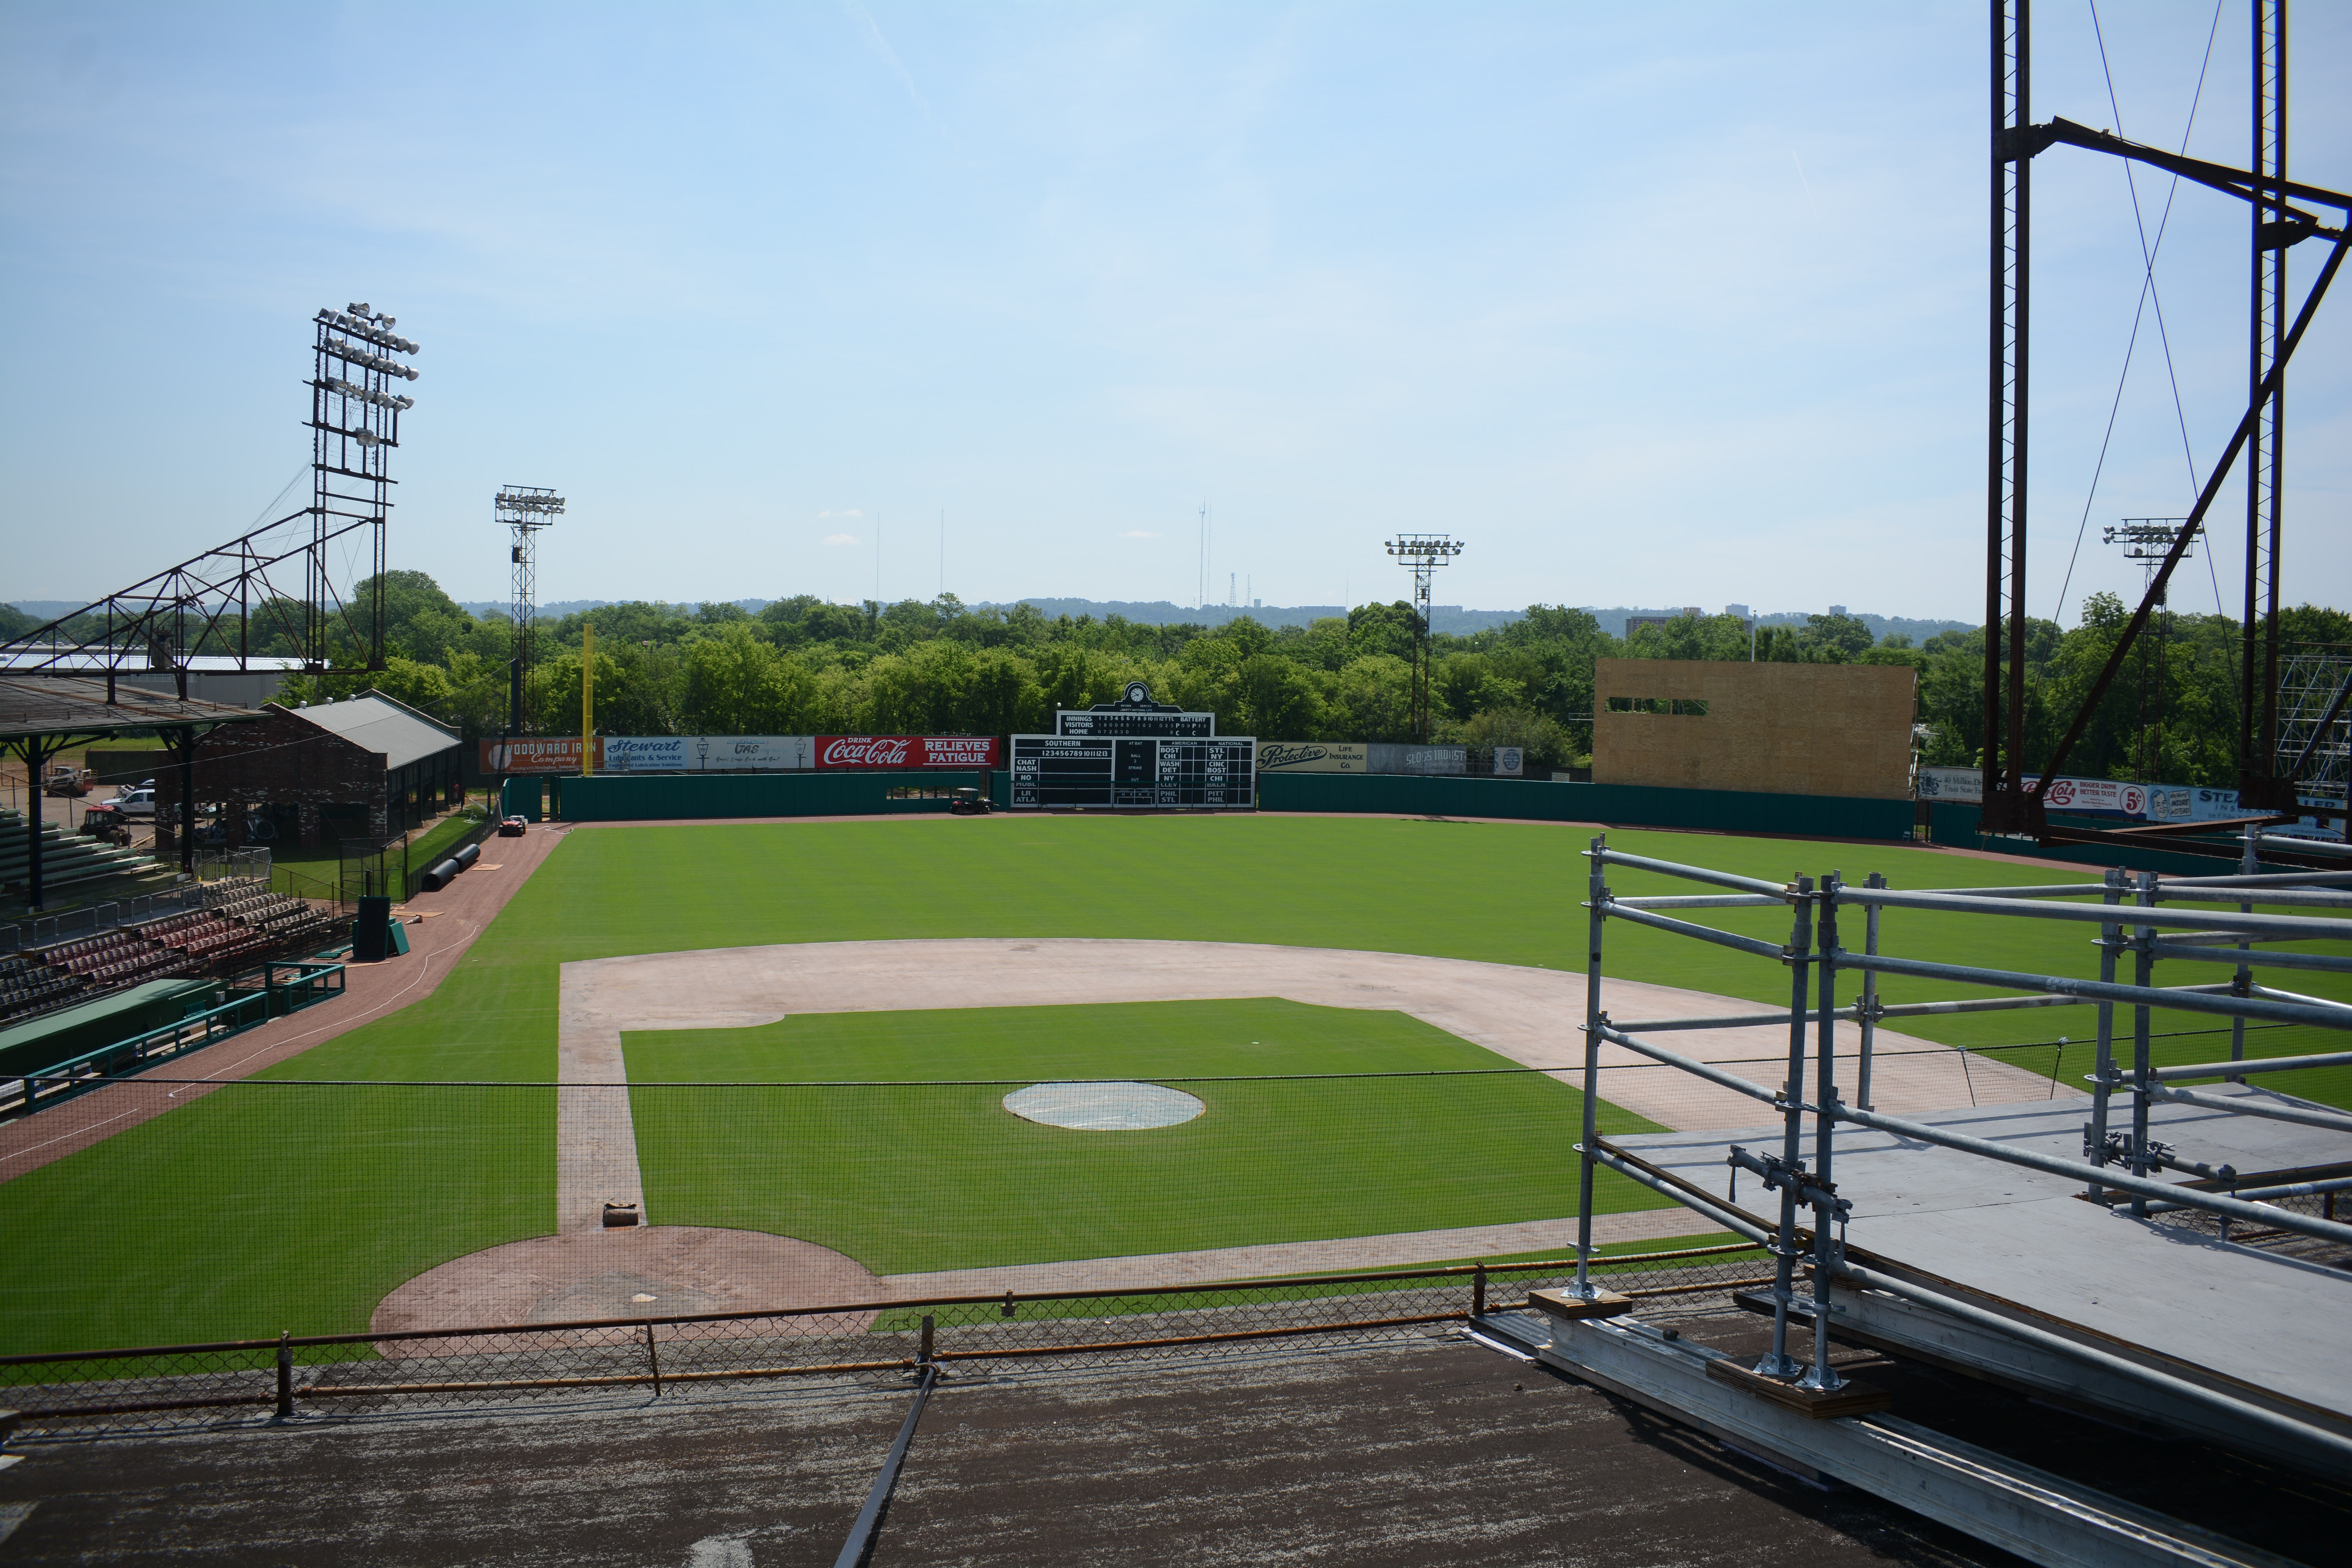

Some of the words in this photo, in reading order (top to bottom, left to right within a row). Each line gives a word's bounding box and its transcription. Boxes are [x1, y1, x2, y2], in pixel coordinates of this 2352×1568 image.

[505, 743, 568, 754] WOODWARD
[607, 740, 682, 753] Stewart
[824, 739, 912, 764] Coca-Cola
[925, 741, 990, 751] RELIEVES
[531, 753, 577, 764] Company
[929, 753, 986, 762] FATIGUE
[1255, 745, 1327, 769] Protective
[1406, 751, 1432, 765] SLOSS
